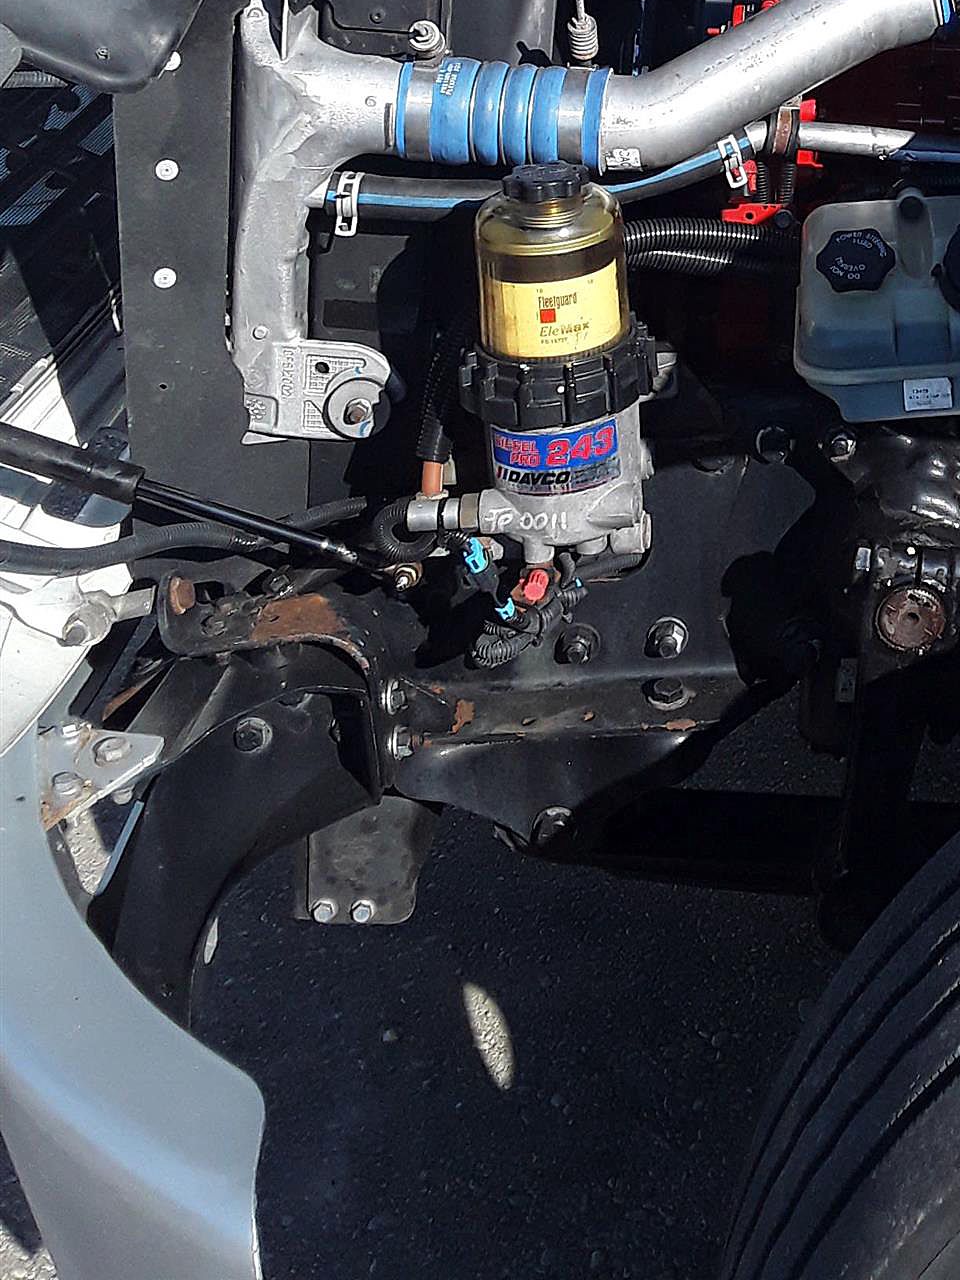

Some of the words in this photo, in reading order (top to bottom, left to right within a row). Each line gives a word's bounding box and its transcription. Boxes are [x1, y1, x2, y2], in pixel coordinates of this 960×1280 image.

[365, 95, 376, 107] 6
[836, 231, 862, 243] POWER
[830, 265, 846, 277] NOT
[847, 272, 860, 280] DO
[538, 291, 578, 310] Fleetguard
[545, 425, 616, 466] 243
[509, 451, 540, 468] PRO
